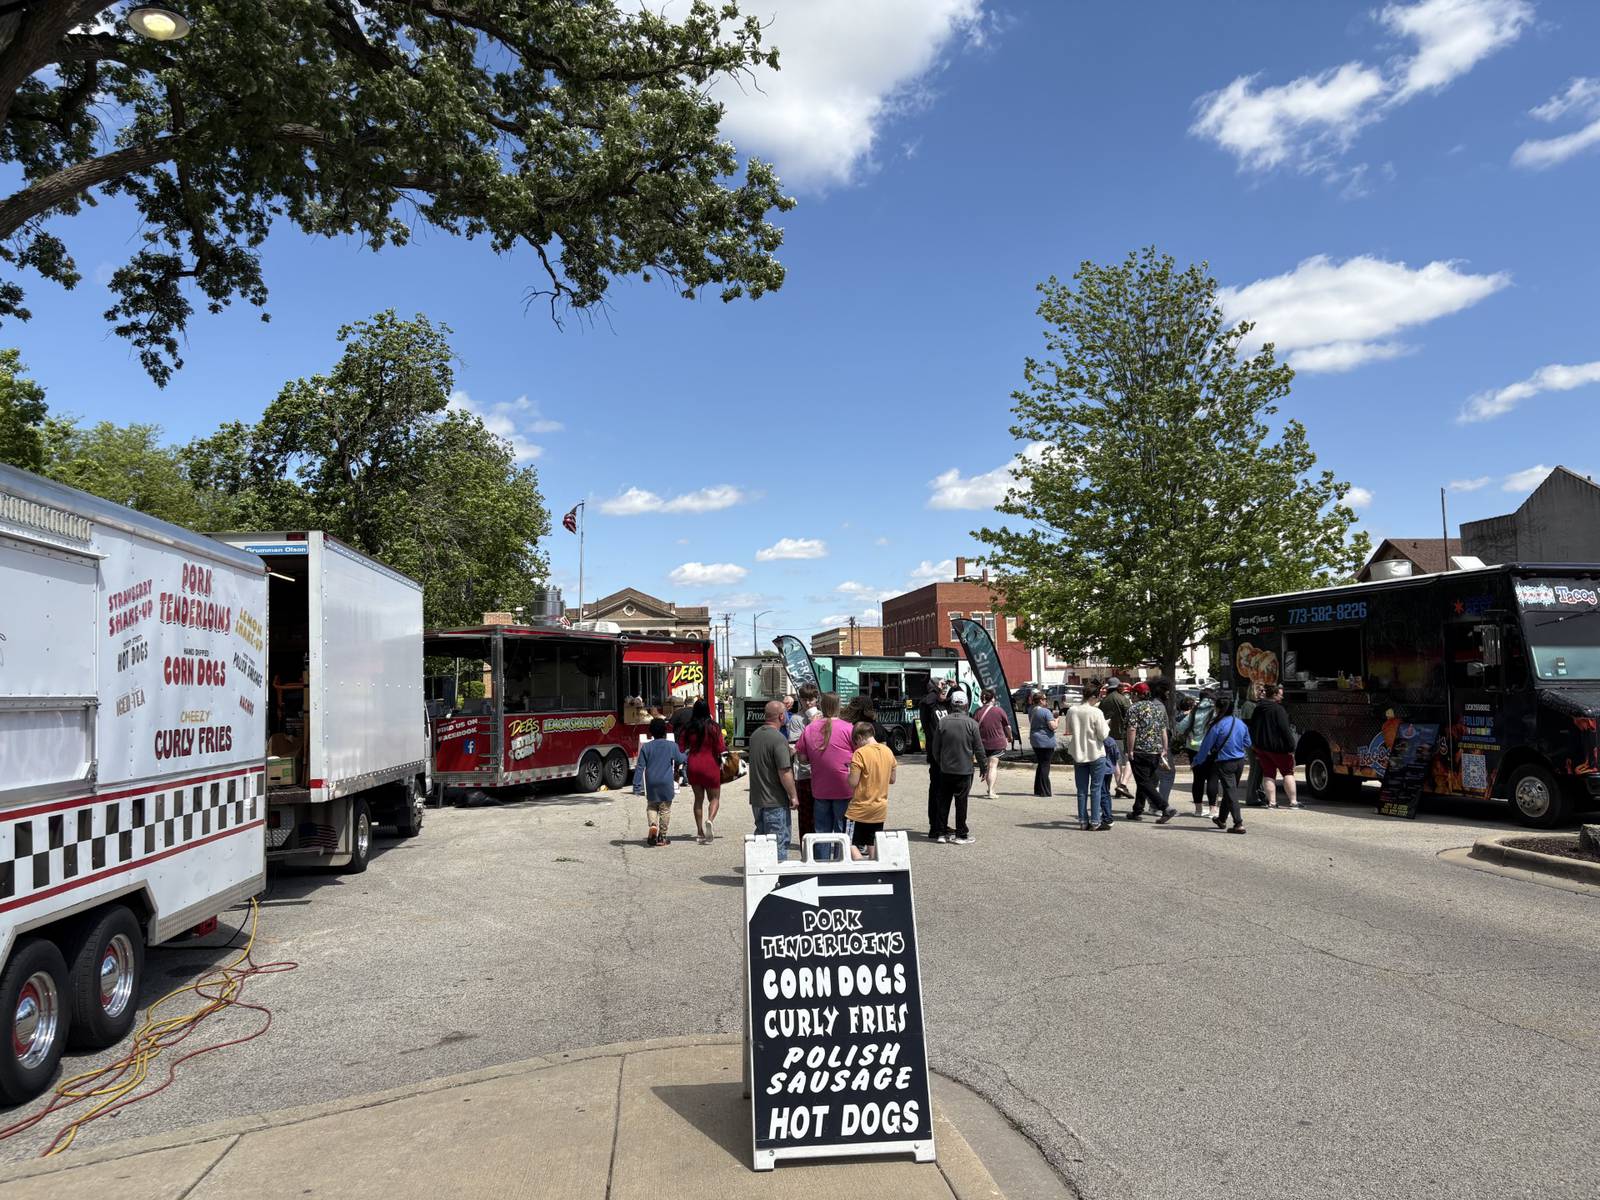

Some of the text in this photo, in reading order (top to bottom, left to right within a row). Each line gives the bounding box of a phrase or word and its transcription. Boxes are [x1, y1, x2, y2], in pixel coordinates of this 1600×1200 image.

[182, 562, 213, 597] PORK
[109, 579, 152, 613] STRAWBERRY
[109, 599, 153, 637] SHAKE-UP
[160, 592, 231, 635] TENDERLOINS
[240, 607, 263, 637] LEMON
[1287, 602, 1367, 625] 773-582-8226
[117, 649, 129, 673] HOT
[131, 641, 148, 666] DOGS
[183, 648, 194, 656] HAND
[164, 655, 194, 686] CORN
[197, 658, 226, 687] DOGS
[180, 711, 210, 723] CHEEZY
[437, 724, 455, 735] FIND
[467, 718, 478, 726] ON
[154, 725, 232, 760] CURLY FRIES
[438, 727, 477, 741] FACEBOOK
[802, 909, 863, 932] PORK
[761, 931, 905, 961] TENDERLOINS
[763, 963, 907, 1000] CORN DOGS
[764, 1001, 909, 1039] CURLY FRIES
[783, 1042, 900, 1070] POLISH
[766, 1066, 913, 1095] SAUSAGE
[769, 1100, 920, 1140] HOT DOGS
